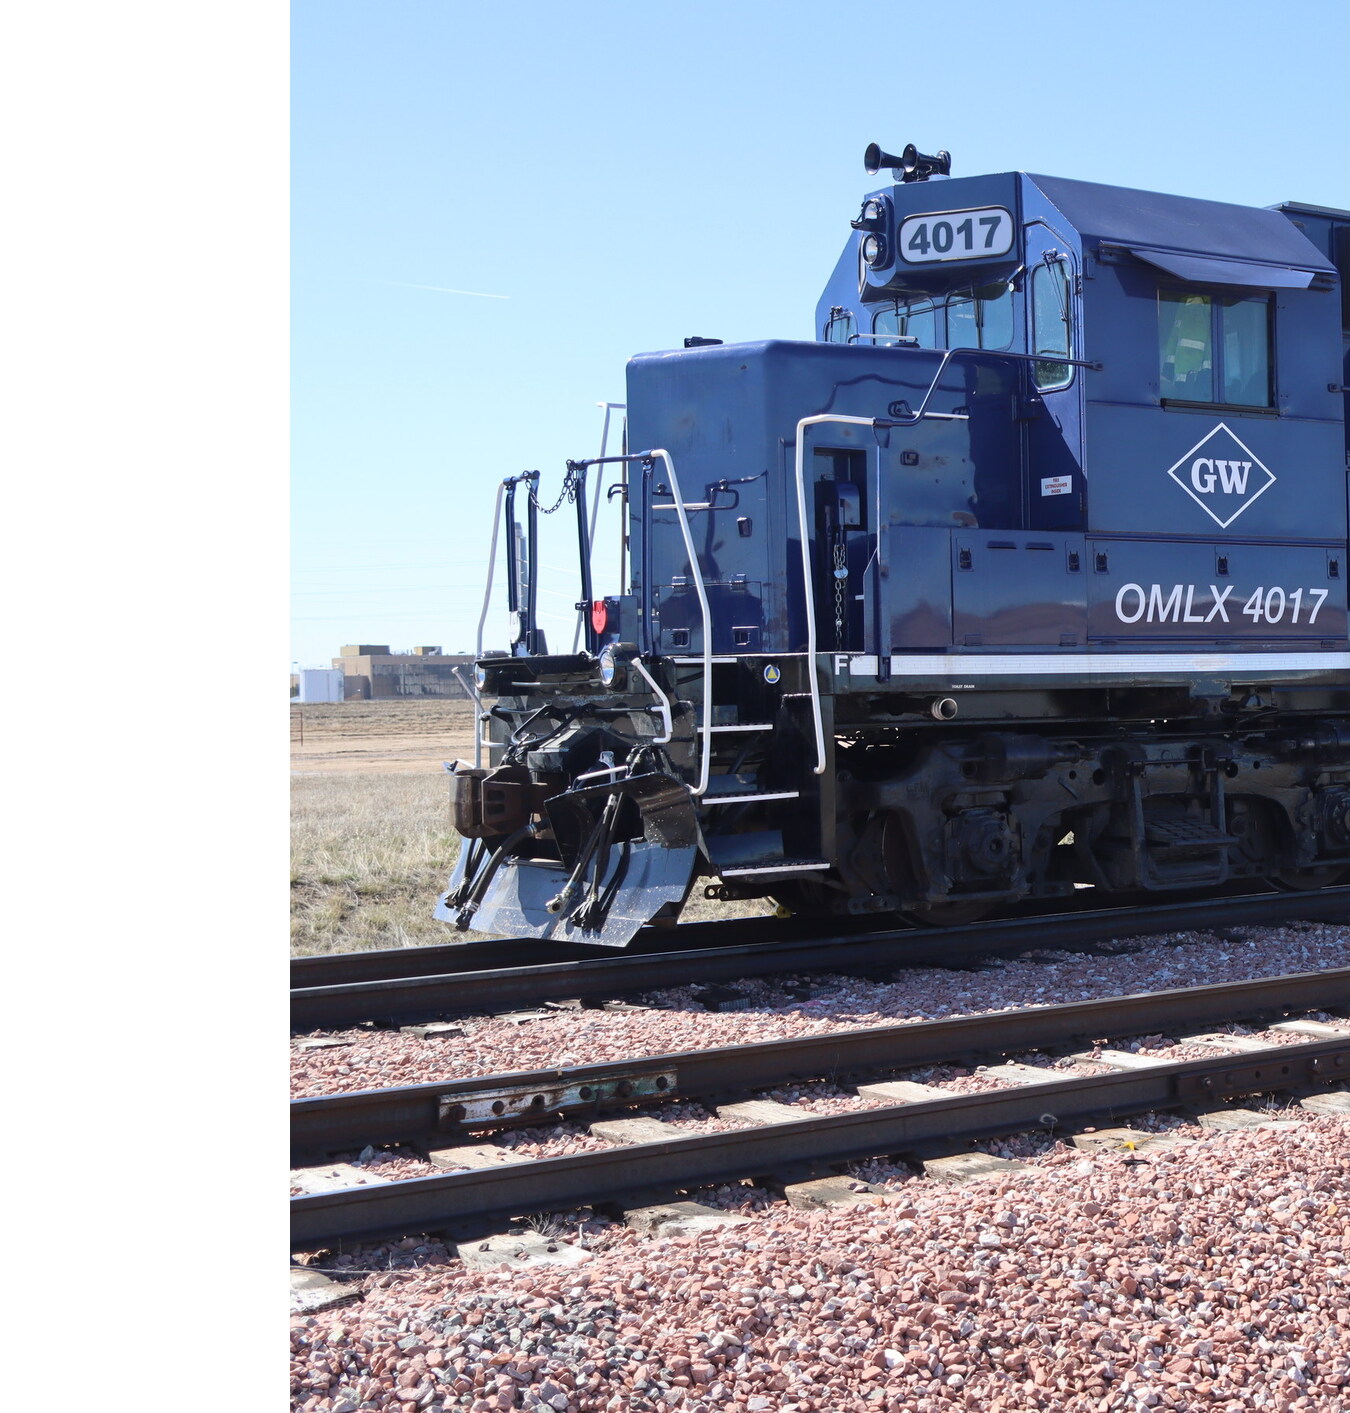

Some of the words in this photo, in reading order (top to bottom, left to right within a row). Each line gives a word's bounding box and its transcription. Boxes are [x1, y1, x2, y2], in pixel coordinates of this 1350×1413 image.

[907, 216, 1002, 255] 4017
[1190, 458, 1252, 494] GW
[1115, 582, 1234, 624] OMLX
[1243, 585, 1329, 625] 4017
[834, 654, 849, 676] F
